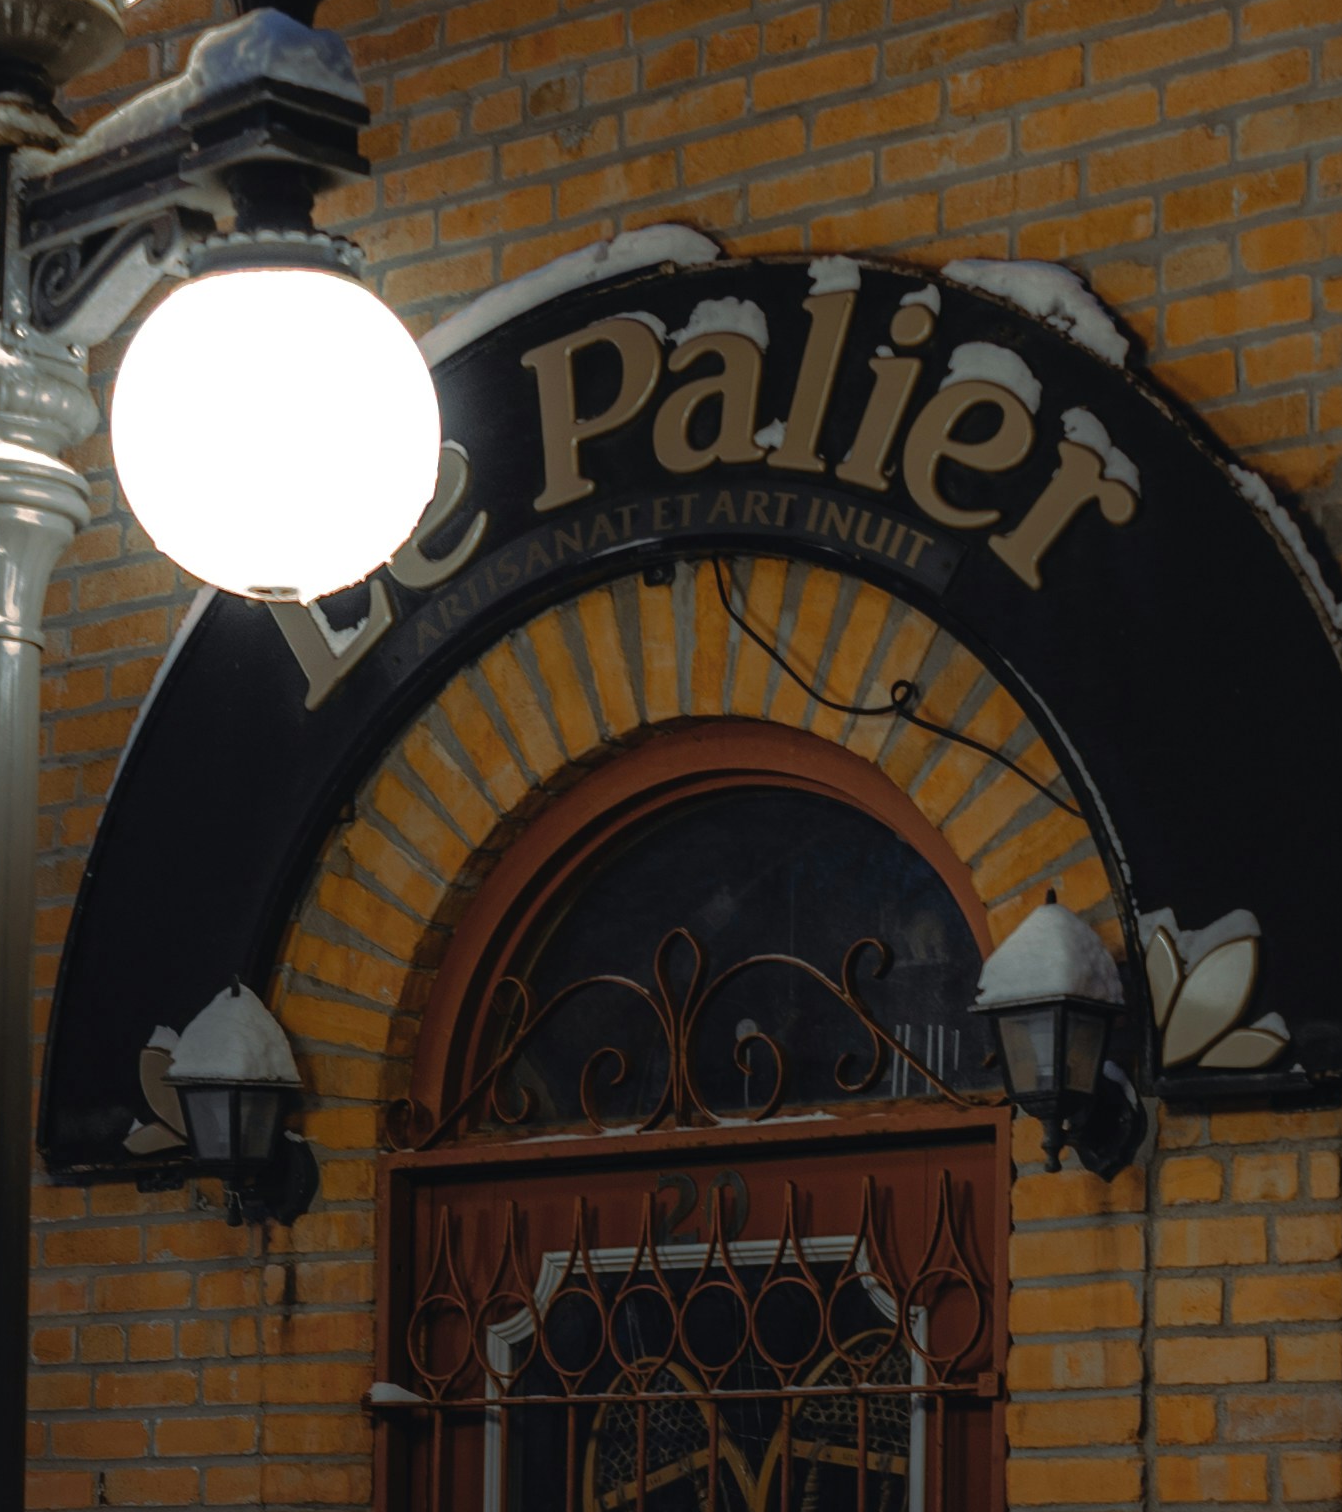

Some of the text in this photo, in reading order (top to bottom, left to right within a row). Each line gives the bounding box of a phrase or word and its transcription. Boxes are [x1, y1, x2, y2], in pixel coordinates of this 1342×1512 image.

[521, 288, 1137, 591] Palier
[415, 490, 935, 655] ARTISANAT ET ART INUIT
[655, 1171, 749, 1245] 20
